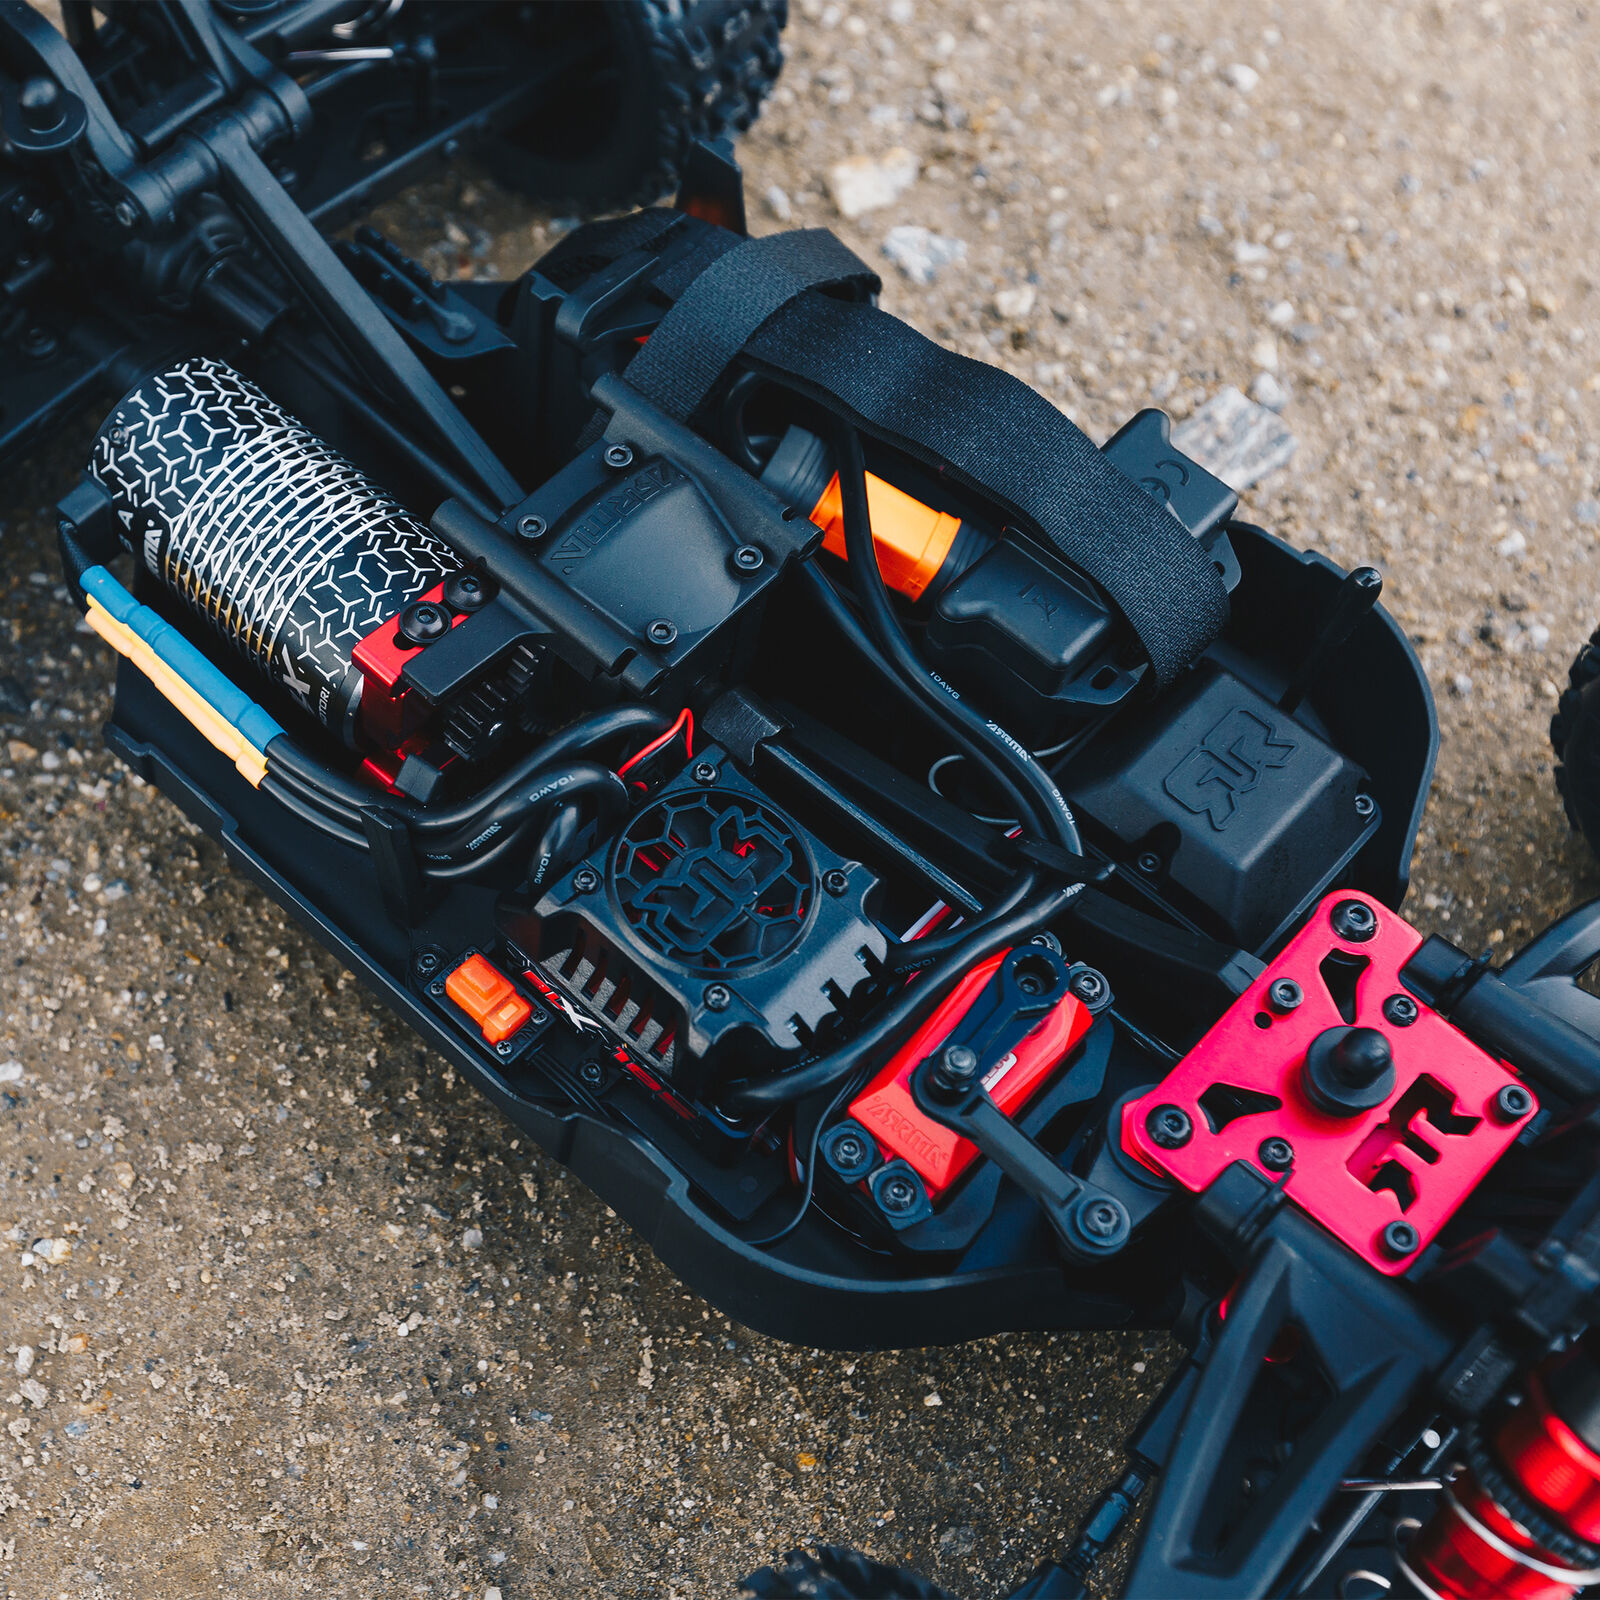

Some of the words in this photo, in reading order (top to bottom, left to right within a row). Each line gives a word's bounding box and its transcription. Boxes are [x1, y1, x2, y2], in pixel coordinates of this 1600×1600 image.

[929, 671, 961, 699] 10AWG
[529, 775, 575, 802] 10AWG
[1052, 788, 1076, 825] 10AWG
